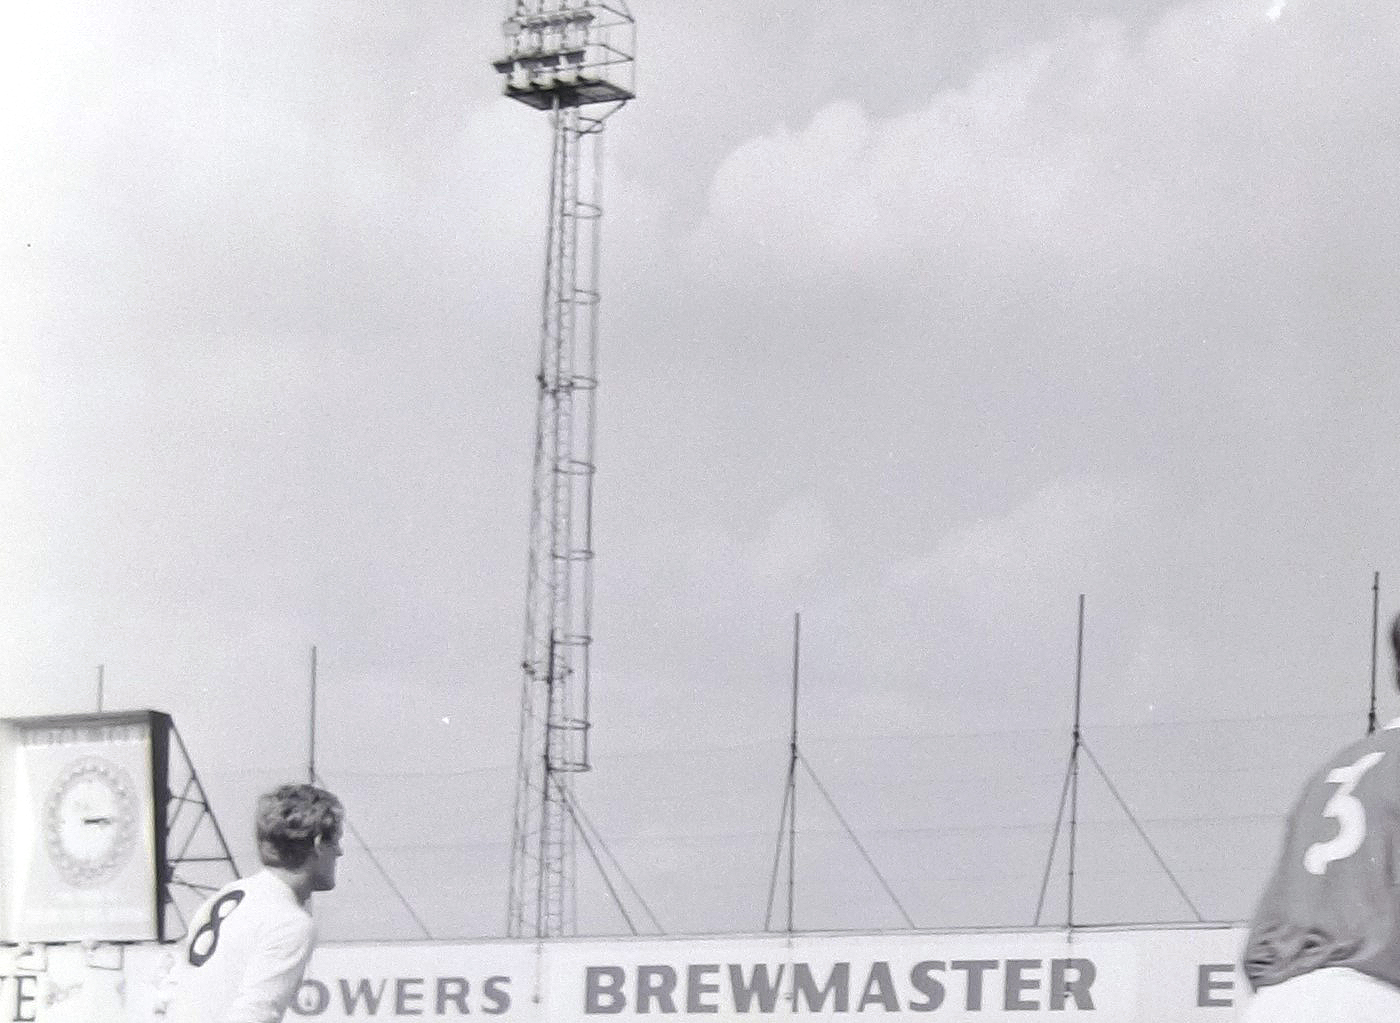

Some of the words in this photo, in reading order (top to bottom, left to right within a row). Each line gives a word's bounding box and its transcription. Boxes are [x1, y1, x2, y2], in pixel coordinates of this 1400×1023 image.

[1303, 751, 1386, 875] 3
[189, 889, 245, 967] 8
[287, 975, 512, 1017] OWERS
[584, 957, 1097, 1015] BREWMASTER
